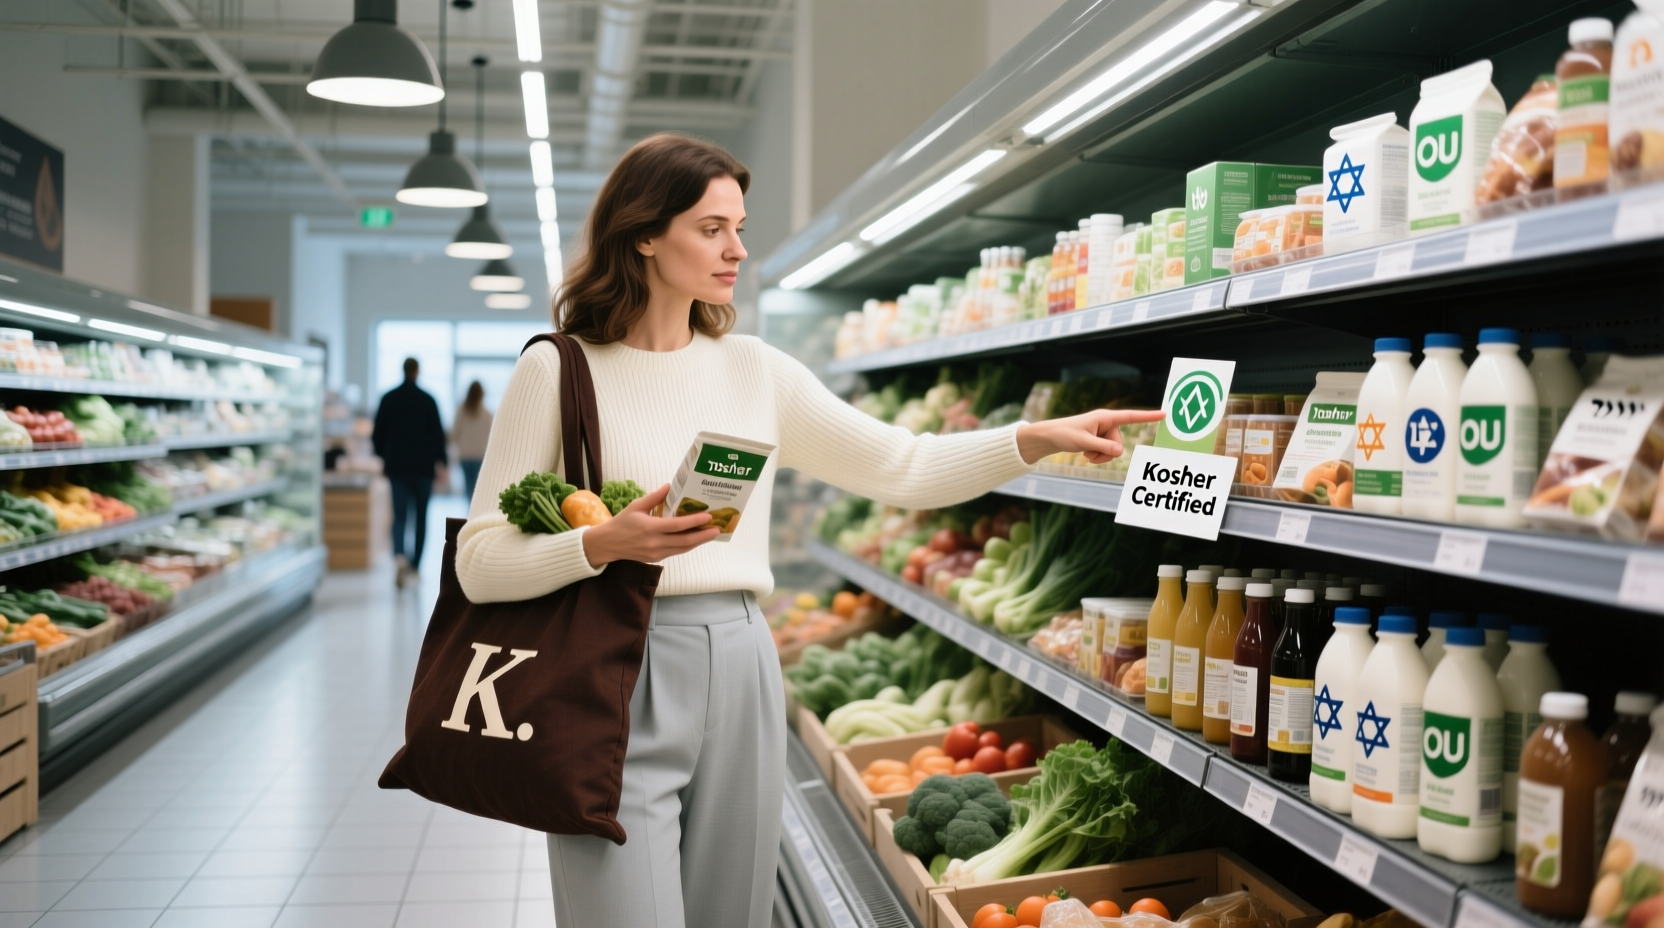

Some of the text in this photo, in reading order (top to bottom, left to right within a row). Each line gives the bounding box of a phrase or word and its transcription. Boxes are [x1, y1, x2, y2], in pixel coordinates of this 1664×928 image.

[1417, 130, 1459, 168] OU
[1460, 418, 1501, 451] OU
[1142, 461, 1217, 490] Kosher
[1131, 485, 1217, 516] Certified
[441, 641, 539, 742] K.
[1423, 726, 1465, 764] OU
